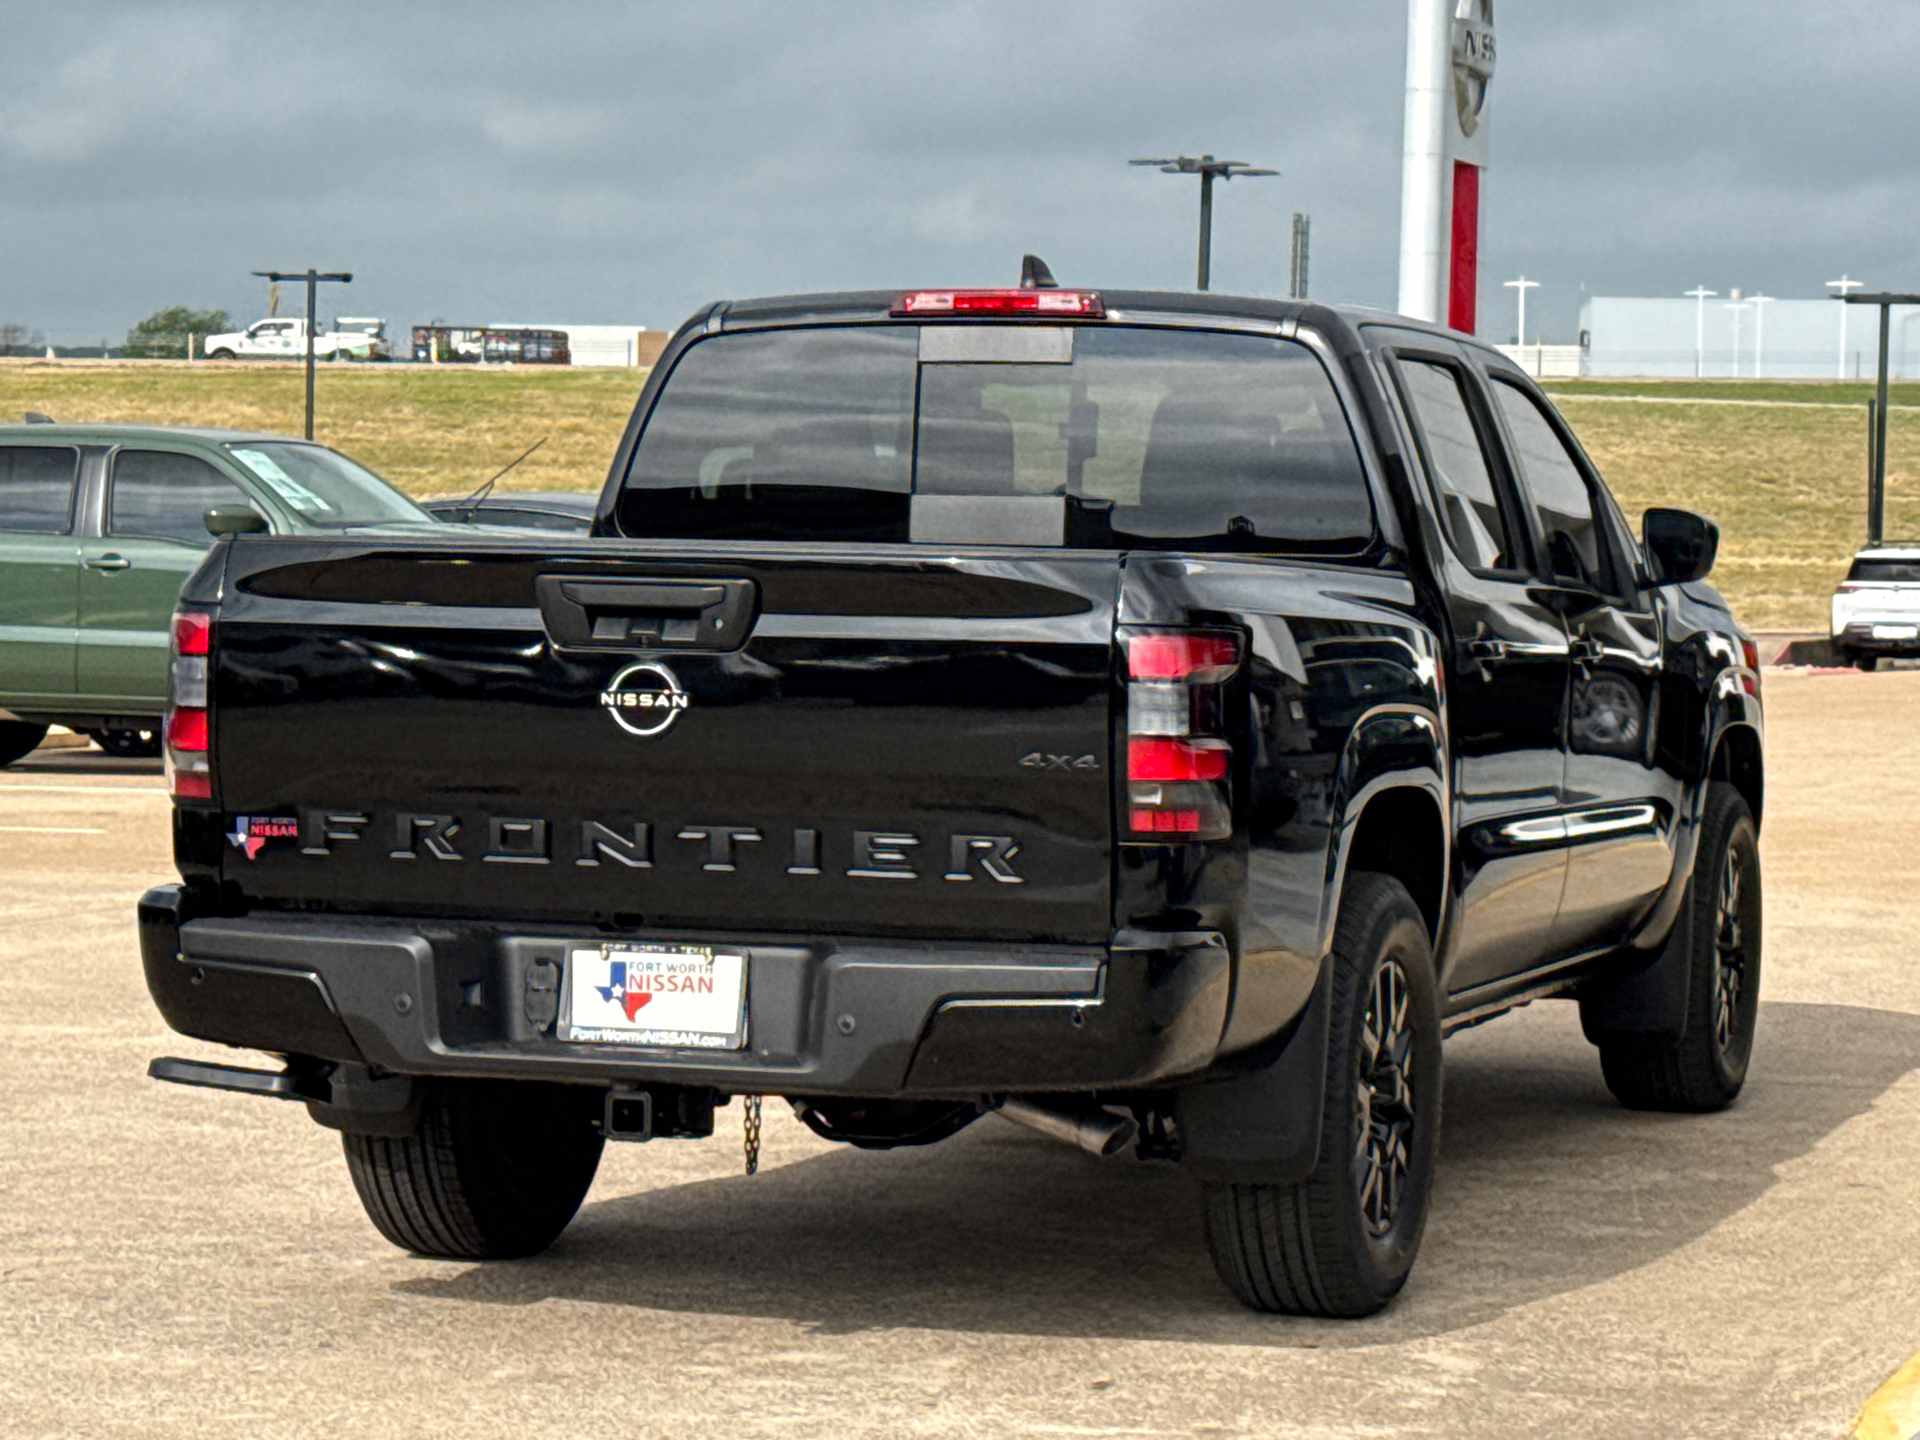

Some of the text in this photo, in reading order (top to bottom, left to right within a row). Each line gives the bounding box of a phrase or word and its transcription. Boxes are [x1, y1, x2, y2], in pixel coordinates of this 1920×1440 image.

[1465, 29, 1496, 61] NISS
[600, 692, 688, 708] NISSAN
[250, 824, 298, 837] NISSAN
[301, 810, 1024, 884] FRONTIER
[629, 961, 714, 974] FORT WORTH
[629, 974, 714, 993] NISSAN
